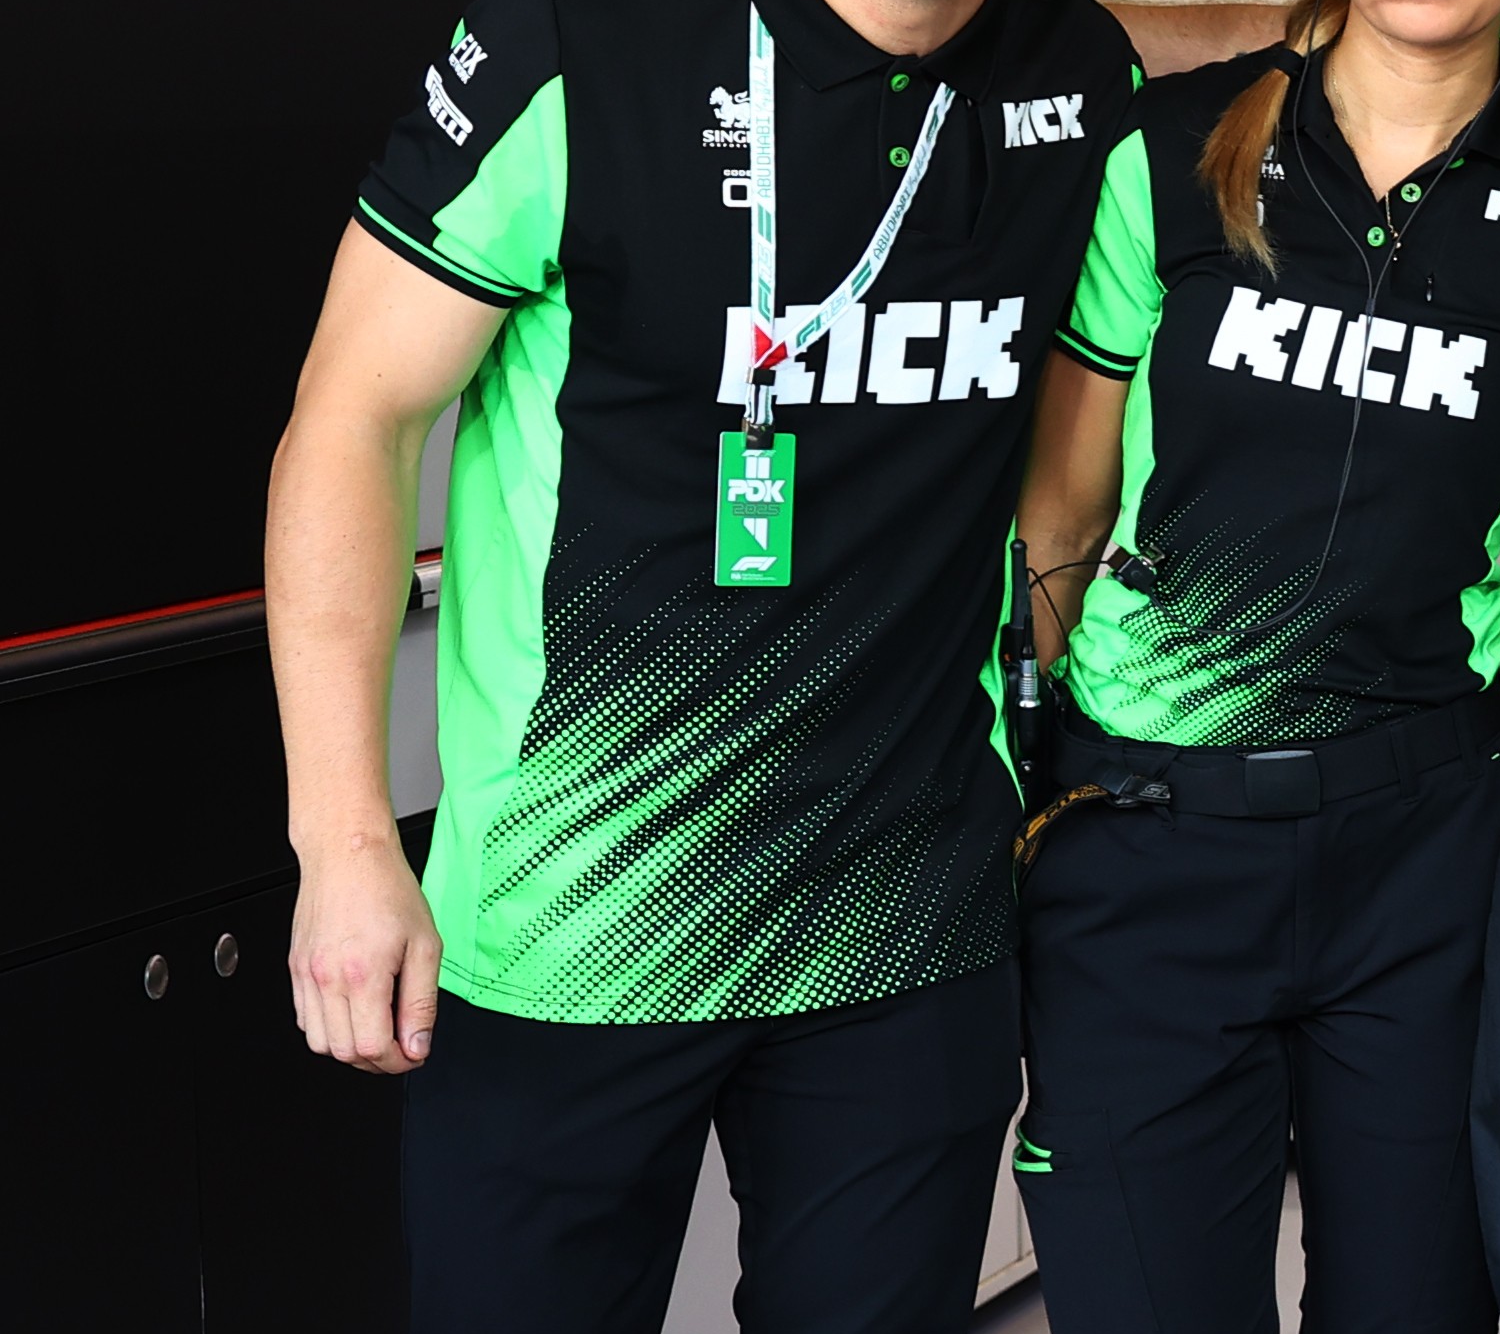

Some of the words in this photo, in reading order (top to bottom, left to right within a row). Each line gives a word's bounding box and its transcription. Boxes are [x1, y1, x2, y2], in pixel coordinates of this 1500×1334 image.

[453, 33, 489, 77] FIX
[702, 129, 751, 144] SING
[1003, 93, 1085, 149] KICK
[717, 297, 1025, 405] KICK
[1208, 286, 1487, 420] KICK
[727, 479, 786, 503] PDK
